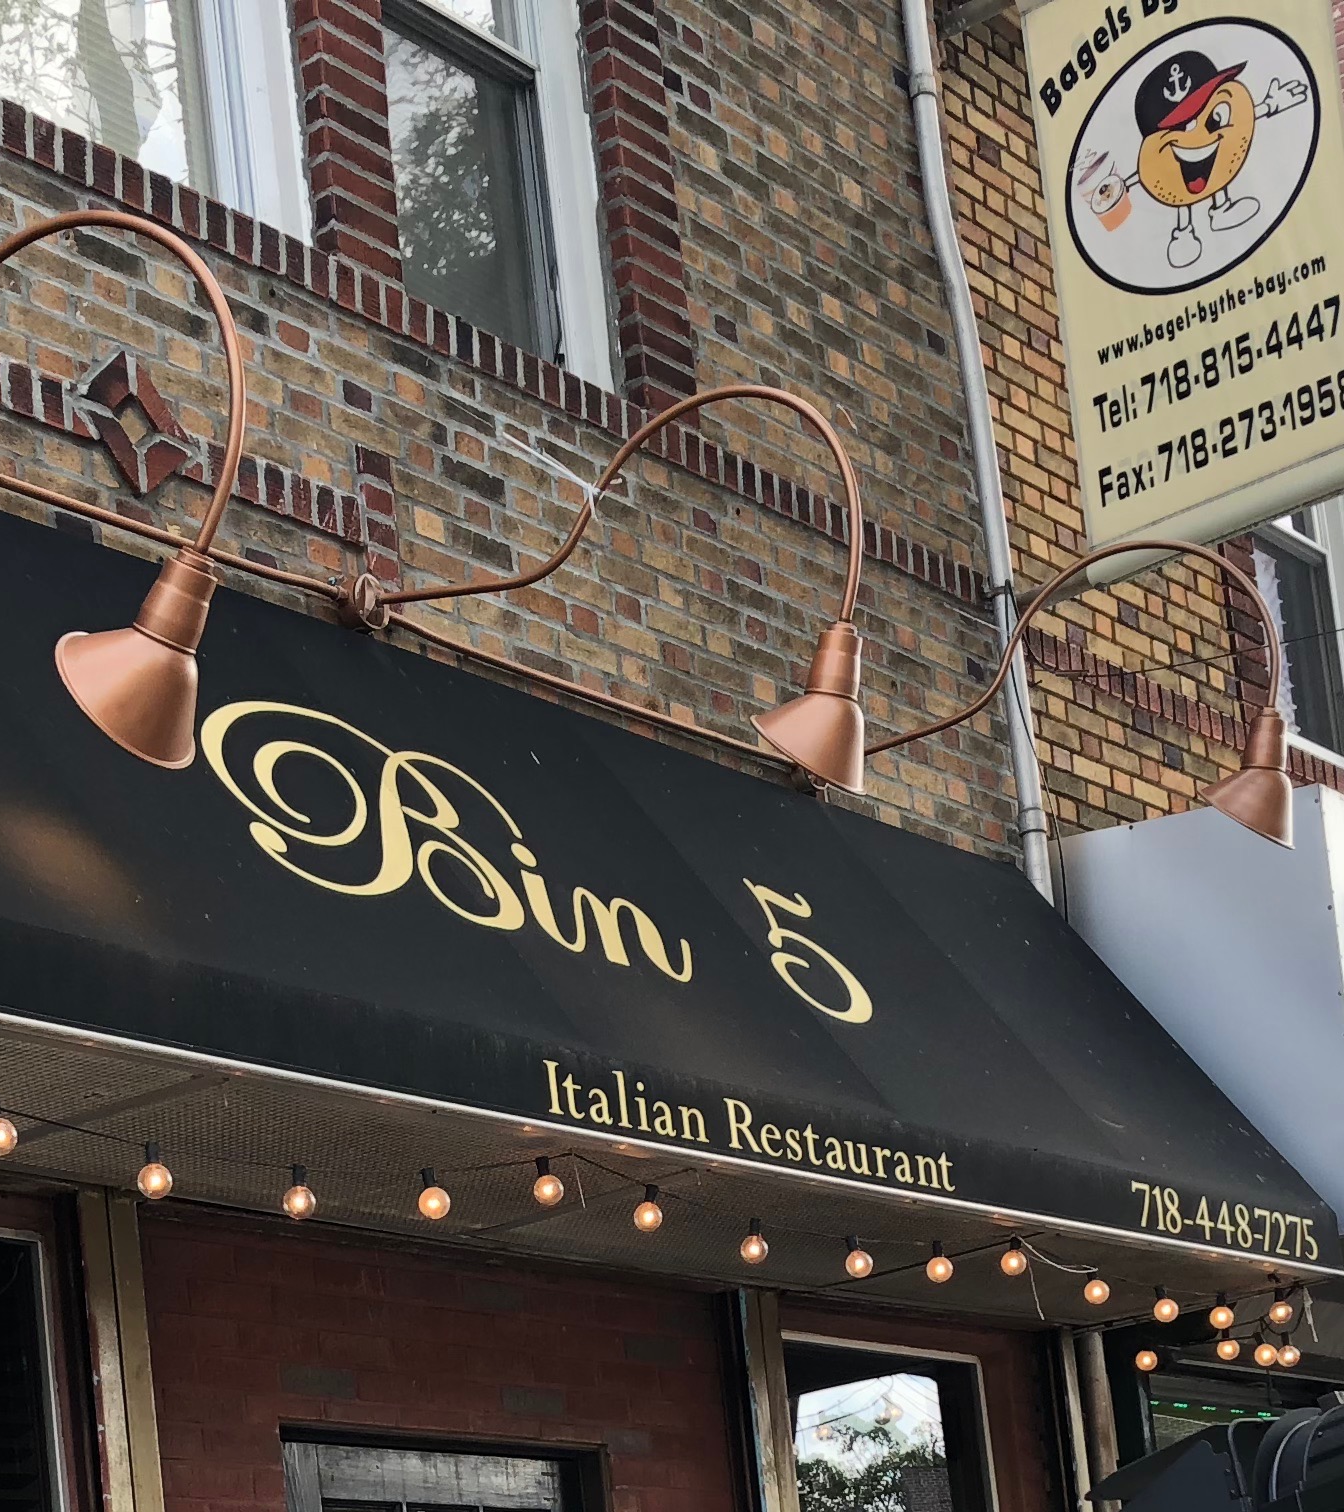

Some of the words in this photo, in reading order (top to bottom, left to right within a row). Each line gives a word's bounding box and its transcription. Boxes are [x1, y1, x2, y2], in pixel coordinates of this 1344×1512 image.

[1039, 5, 1132, 118] Bagels
[1096, 253, 1327, 366] www.bagel-bythe-bay.com
[199, 700, 694, 984] Bin
[743, 876, 873, 1025] 5
[542, 1059, 710, 1144] Italian
[722, 1097, 956, 1192] Restaurant
[1131, 1180, 1319, 1261] 718-448-7275
